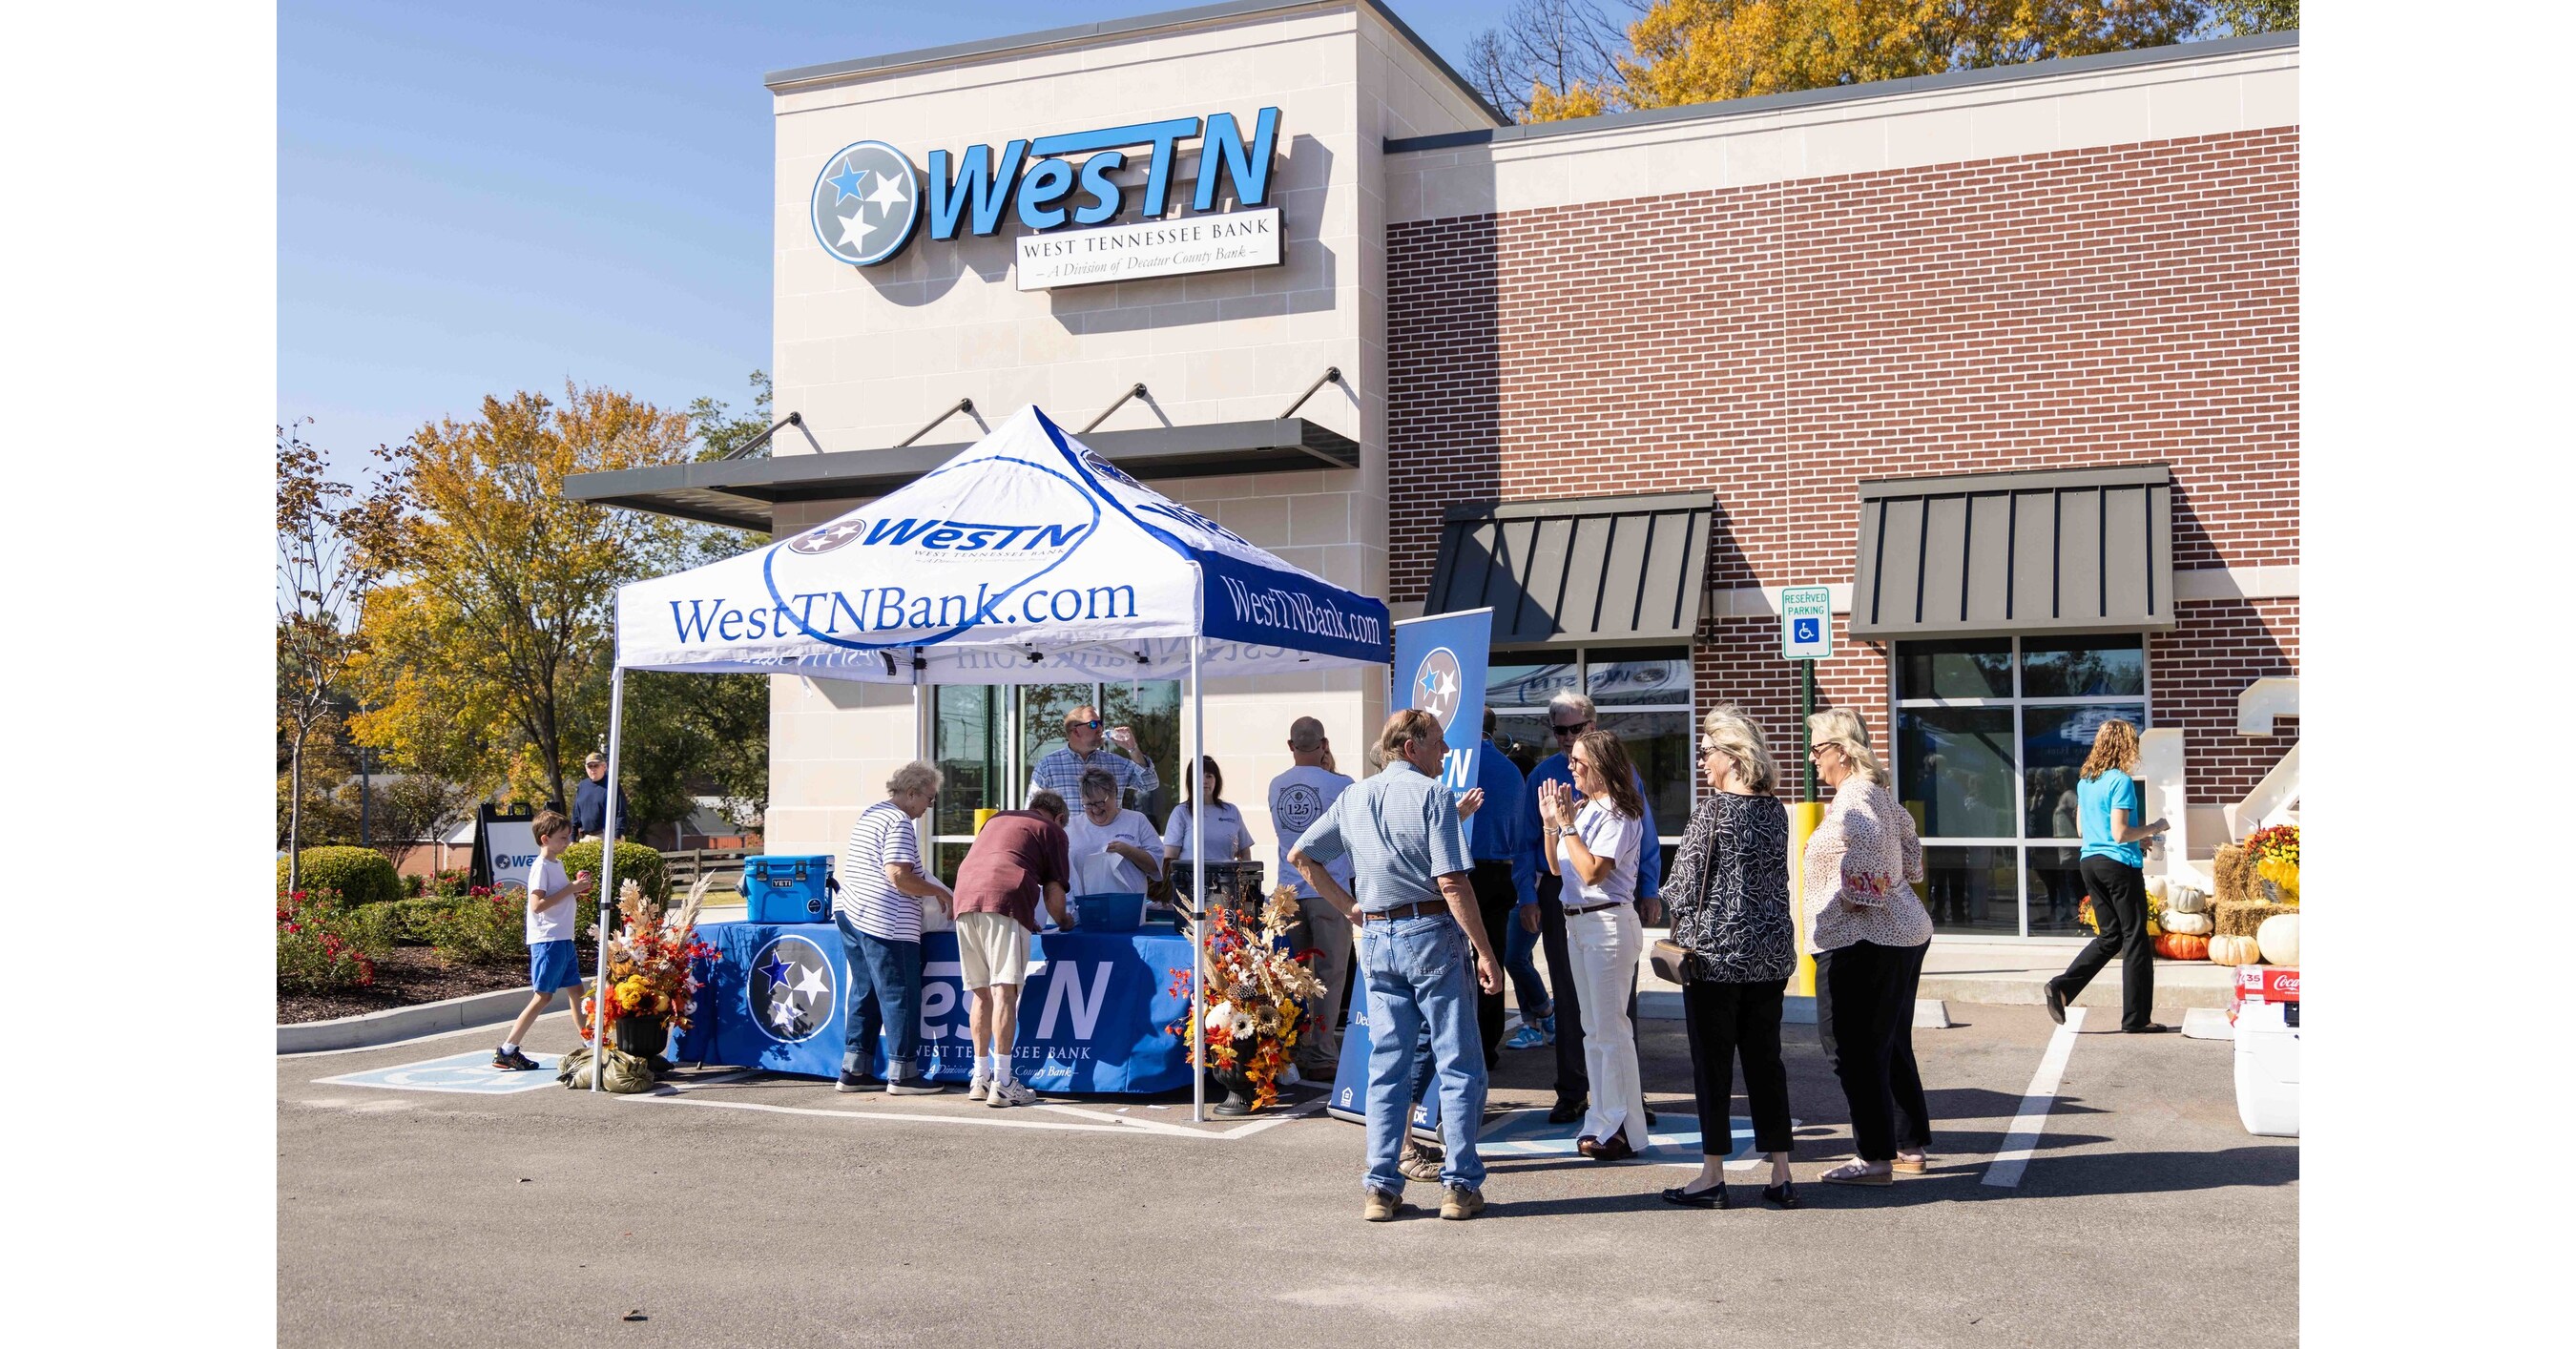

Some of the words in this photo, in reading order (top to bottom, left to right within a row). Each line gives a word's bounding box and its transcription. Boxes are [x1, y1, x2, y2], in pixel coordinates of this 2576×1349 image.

[928, 106, 1282, 241] WesTN
[1024, 239, 1076, 259] WEST
[1085, 226, 1202, 252] TENNESSEE
[1212, 218, 1270, 239] BANK
[1048, 266, 1059, 278] A
[1064, 260, 1107, 277] Division
[1110, 258, 1124, 276] of
[1127, 256, 1171, 271] Decatur
[1173, 250, 1212, 266] County
[1215, 244, 1246, 260] Bank
[862, 518, 1090, 550] WesTN
[914, 550, 950, 558] WEST
[1030, 548, 1066, 557] BANK
[1784, 592, 1827, 604] RESERVED
[669, 583, 1139, 644] WestTNBank.com
[1219, 575, 1381, 645] WestTNBank.com
[1787, 606, 1824, 616] PARKING
[1288, 804, 1309, 815] 125
[2246, 974, 2261, 983] 35
[2274, 975, 2299, 990] Coca
[1048, 1046, 1091, 1060] BANK
[928, 1064, 936, 1074] A
[939, 1064, 968, 1074] Division
[1014, 1065, 1046, 1080] County
[1048, 1065, 1072, 1077] Bank
[1413, 1110, 1427, 1124] DIC
